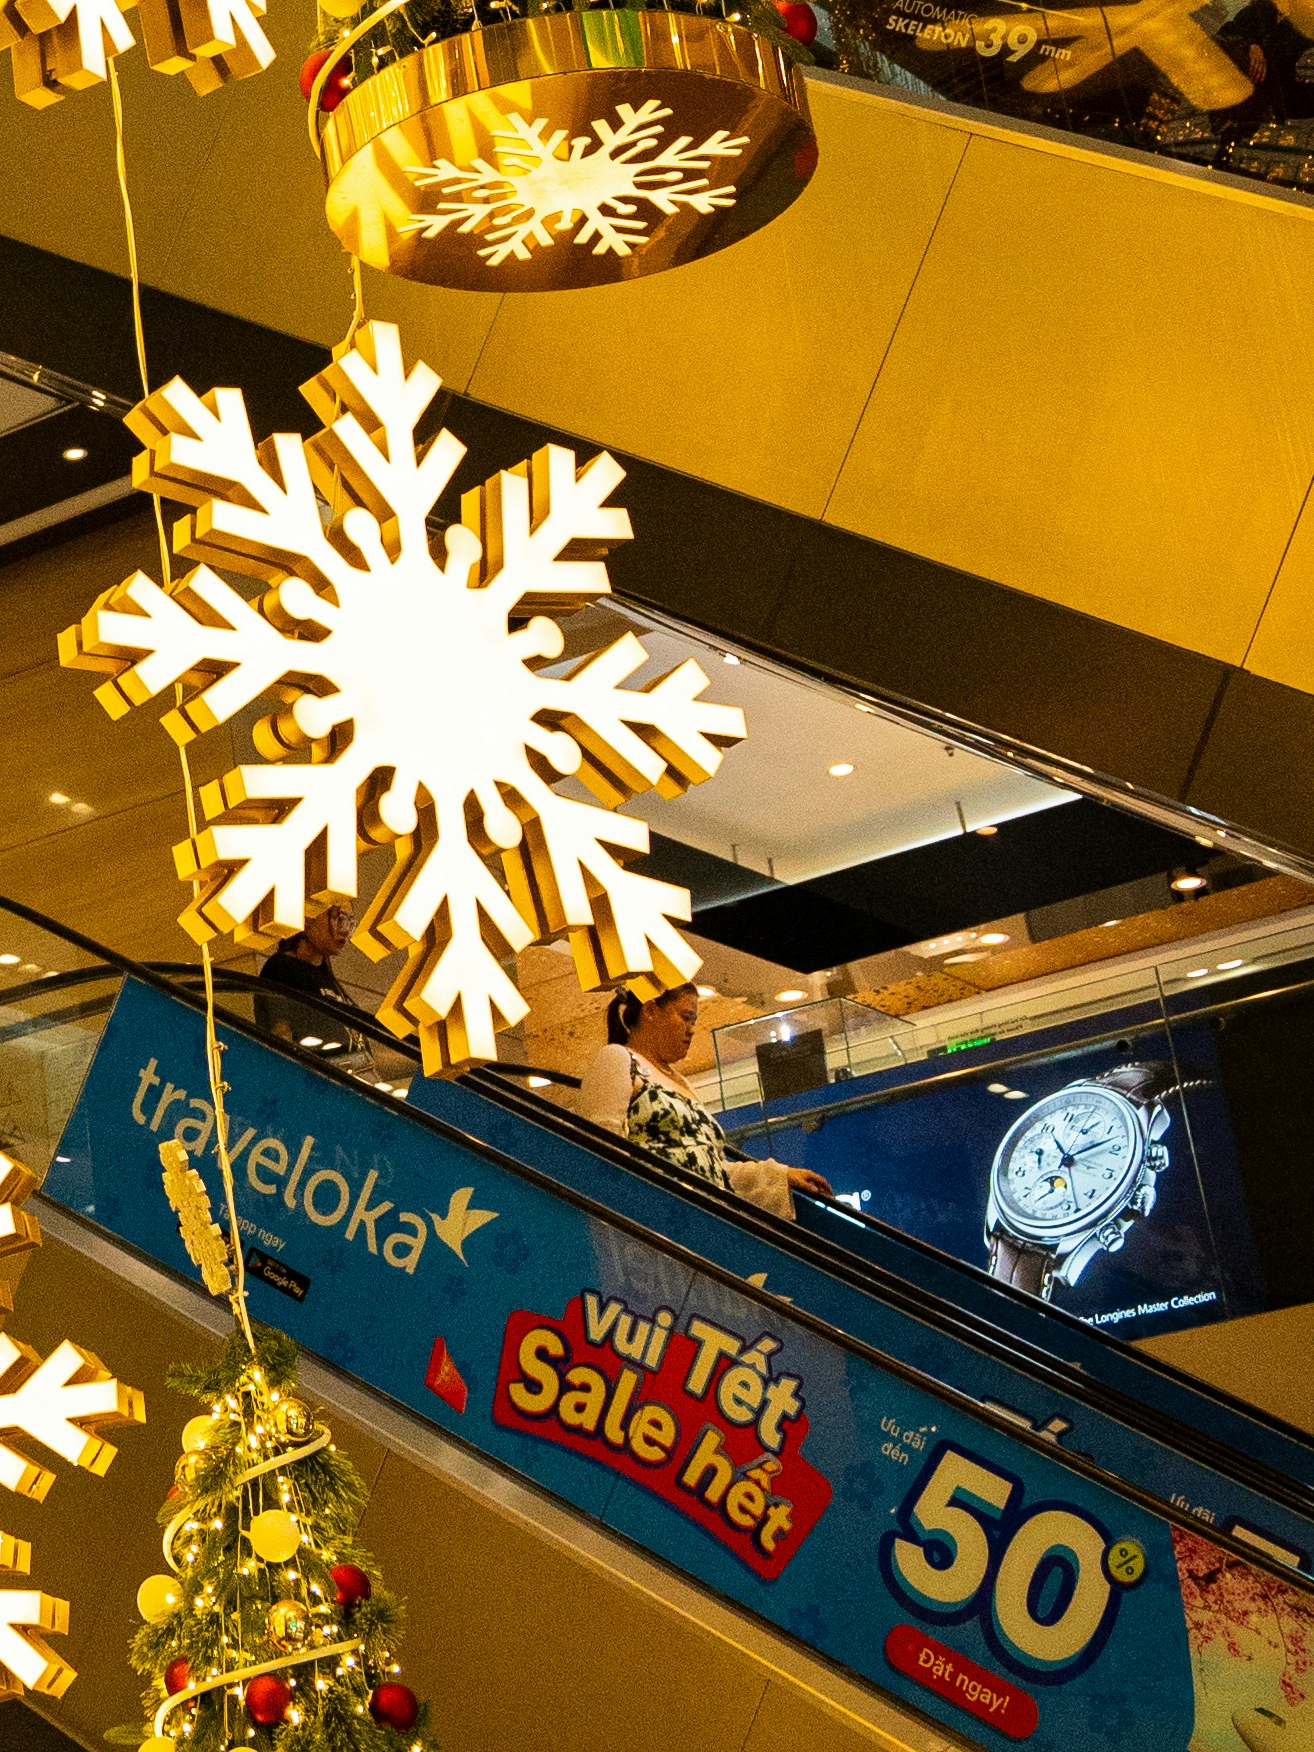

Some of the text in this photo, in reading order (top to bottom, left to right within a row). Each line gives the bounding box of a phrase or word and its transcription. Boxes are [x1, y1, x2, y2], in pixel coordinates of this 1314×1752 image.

[886, 15, 1072, 63] SKELETON 39 mm
[131, 1057, 429, 1275] traveloka
[257, 1228, 286, 1253] ngay
[1094, 1307, 1137, 1325] Longines
[1138, 1300, 1170, 1315] Master
[1170, 1290, 1217, 1310] Collection
[685, 1318, 802, 1452] Tết
[508, 1328, 795, 1553] Sale hết
[880, 1442, 910, 1465] đến
[918, 1648, 1010, 1714] Đặt ngay!
